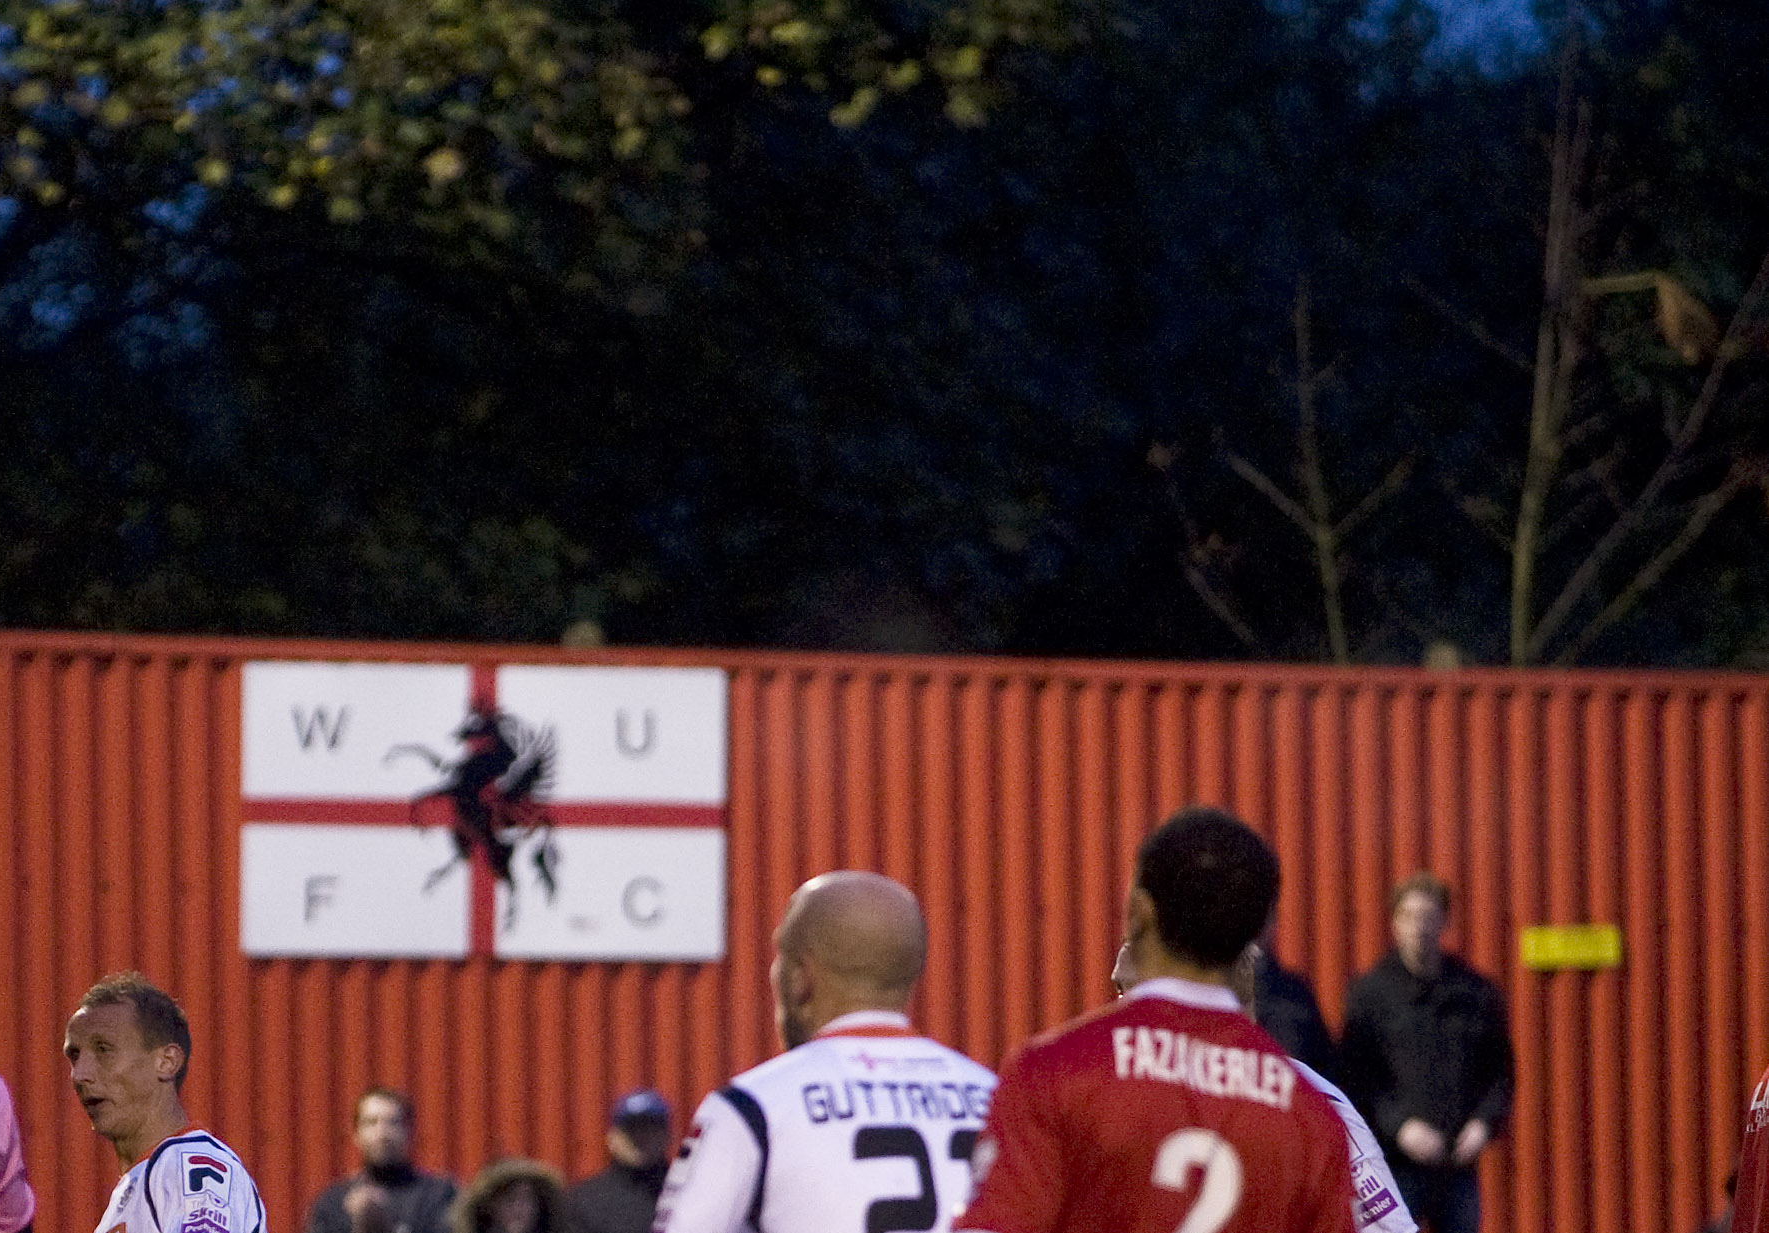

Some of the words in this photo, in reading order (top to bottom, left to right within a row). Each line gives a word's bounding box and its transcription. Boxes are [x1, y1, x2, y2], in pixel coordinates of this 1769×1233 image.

[290, 703, 350, 752] W
[615, 708, 657, 759] U
[303, 874, 339, 923] F
[622, 875, 664, 928] C
[801, 1078, 990, 1124] GUTTRIDG
[188, 1206, 228, 1227] Skrill
[1358, 1196, 1392, 1222] remier
